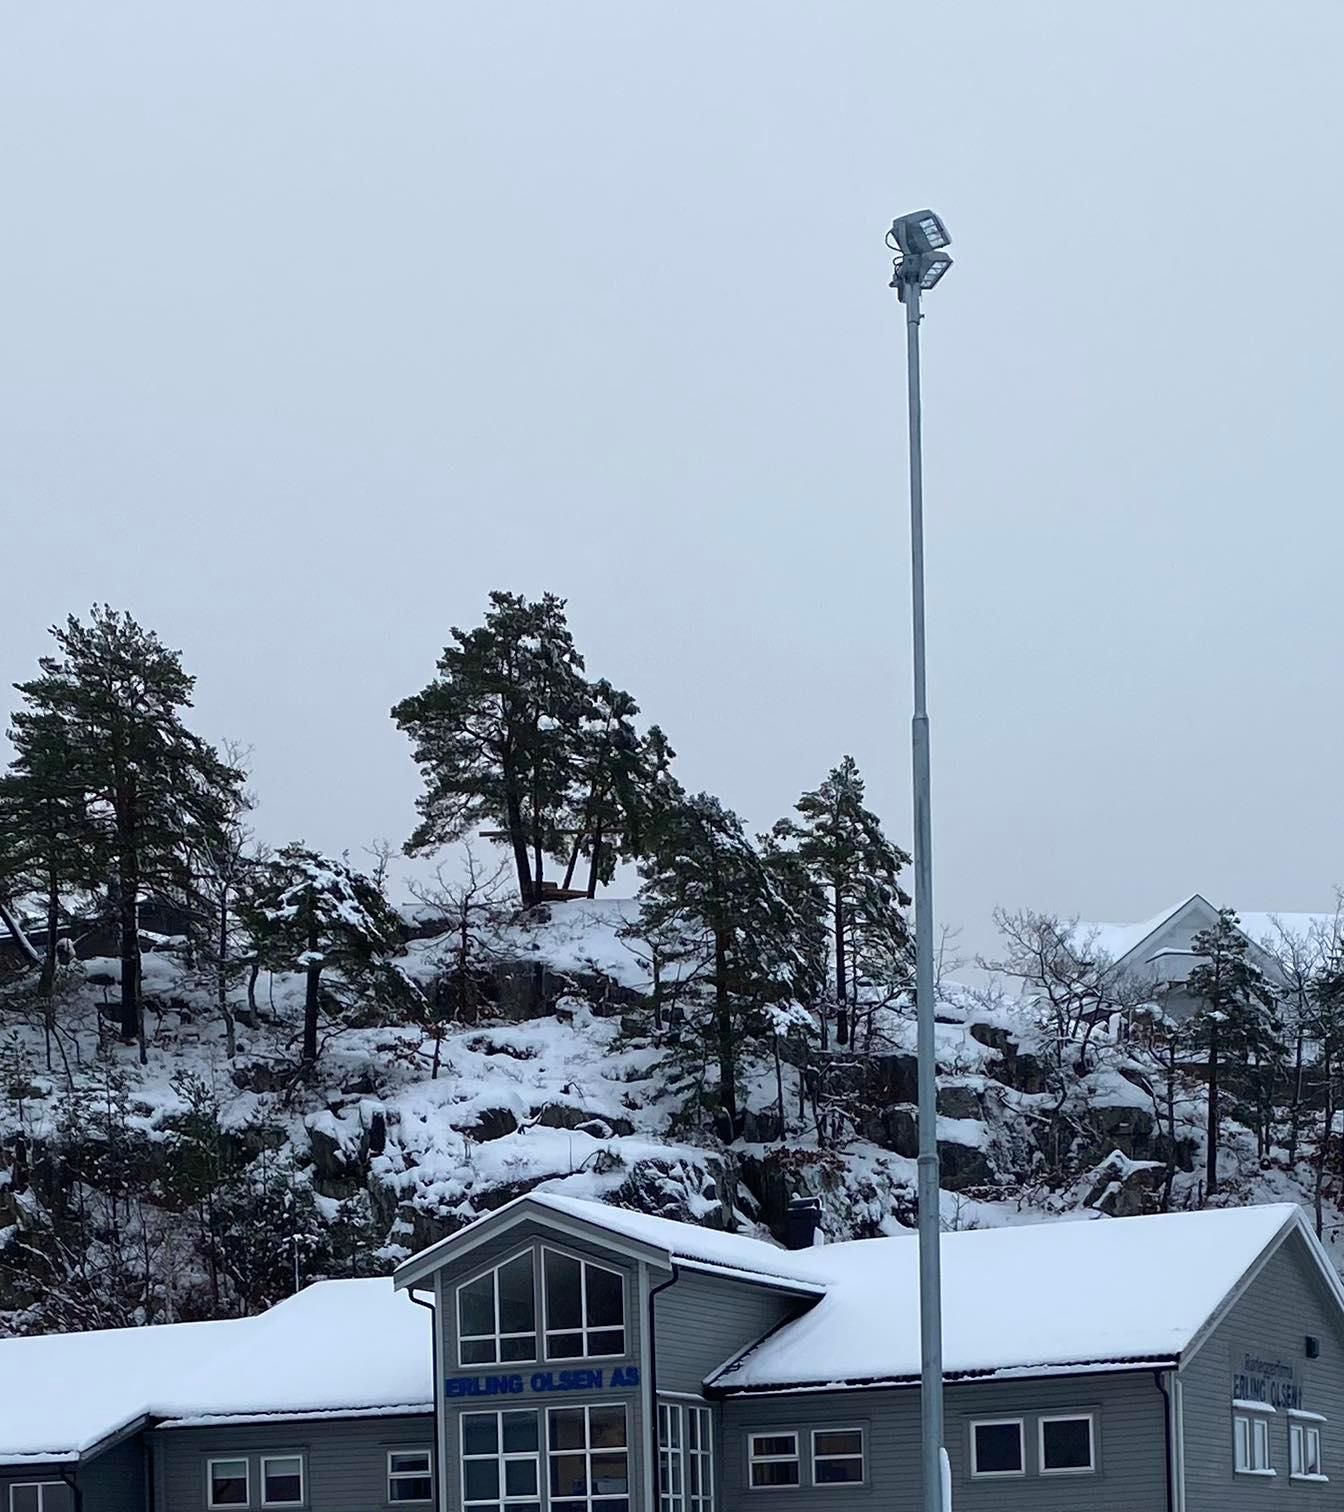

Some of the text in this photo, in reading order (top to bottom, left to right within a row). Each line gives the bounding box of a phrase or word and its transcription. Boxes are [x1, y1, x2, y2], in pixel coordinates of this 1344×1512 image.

[446, 1366, 640, 1397] ERLING OLSEN AS
